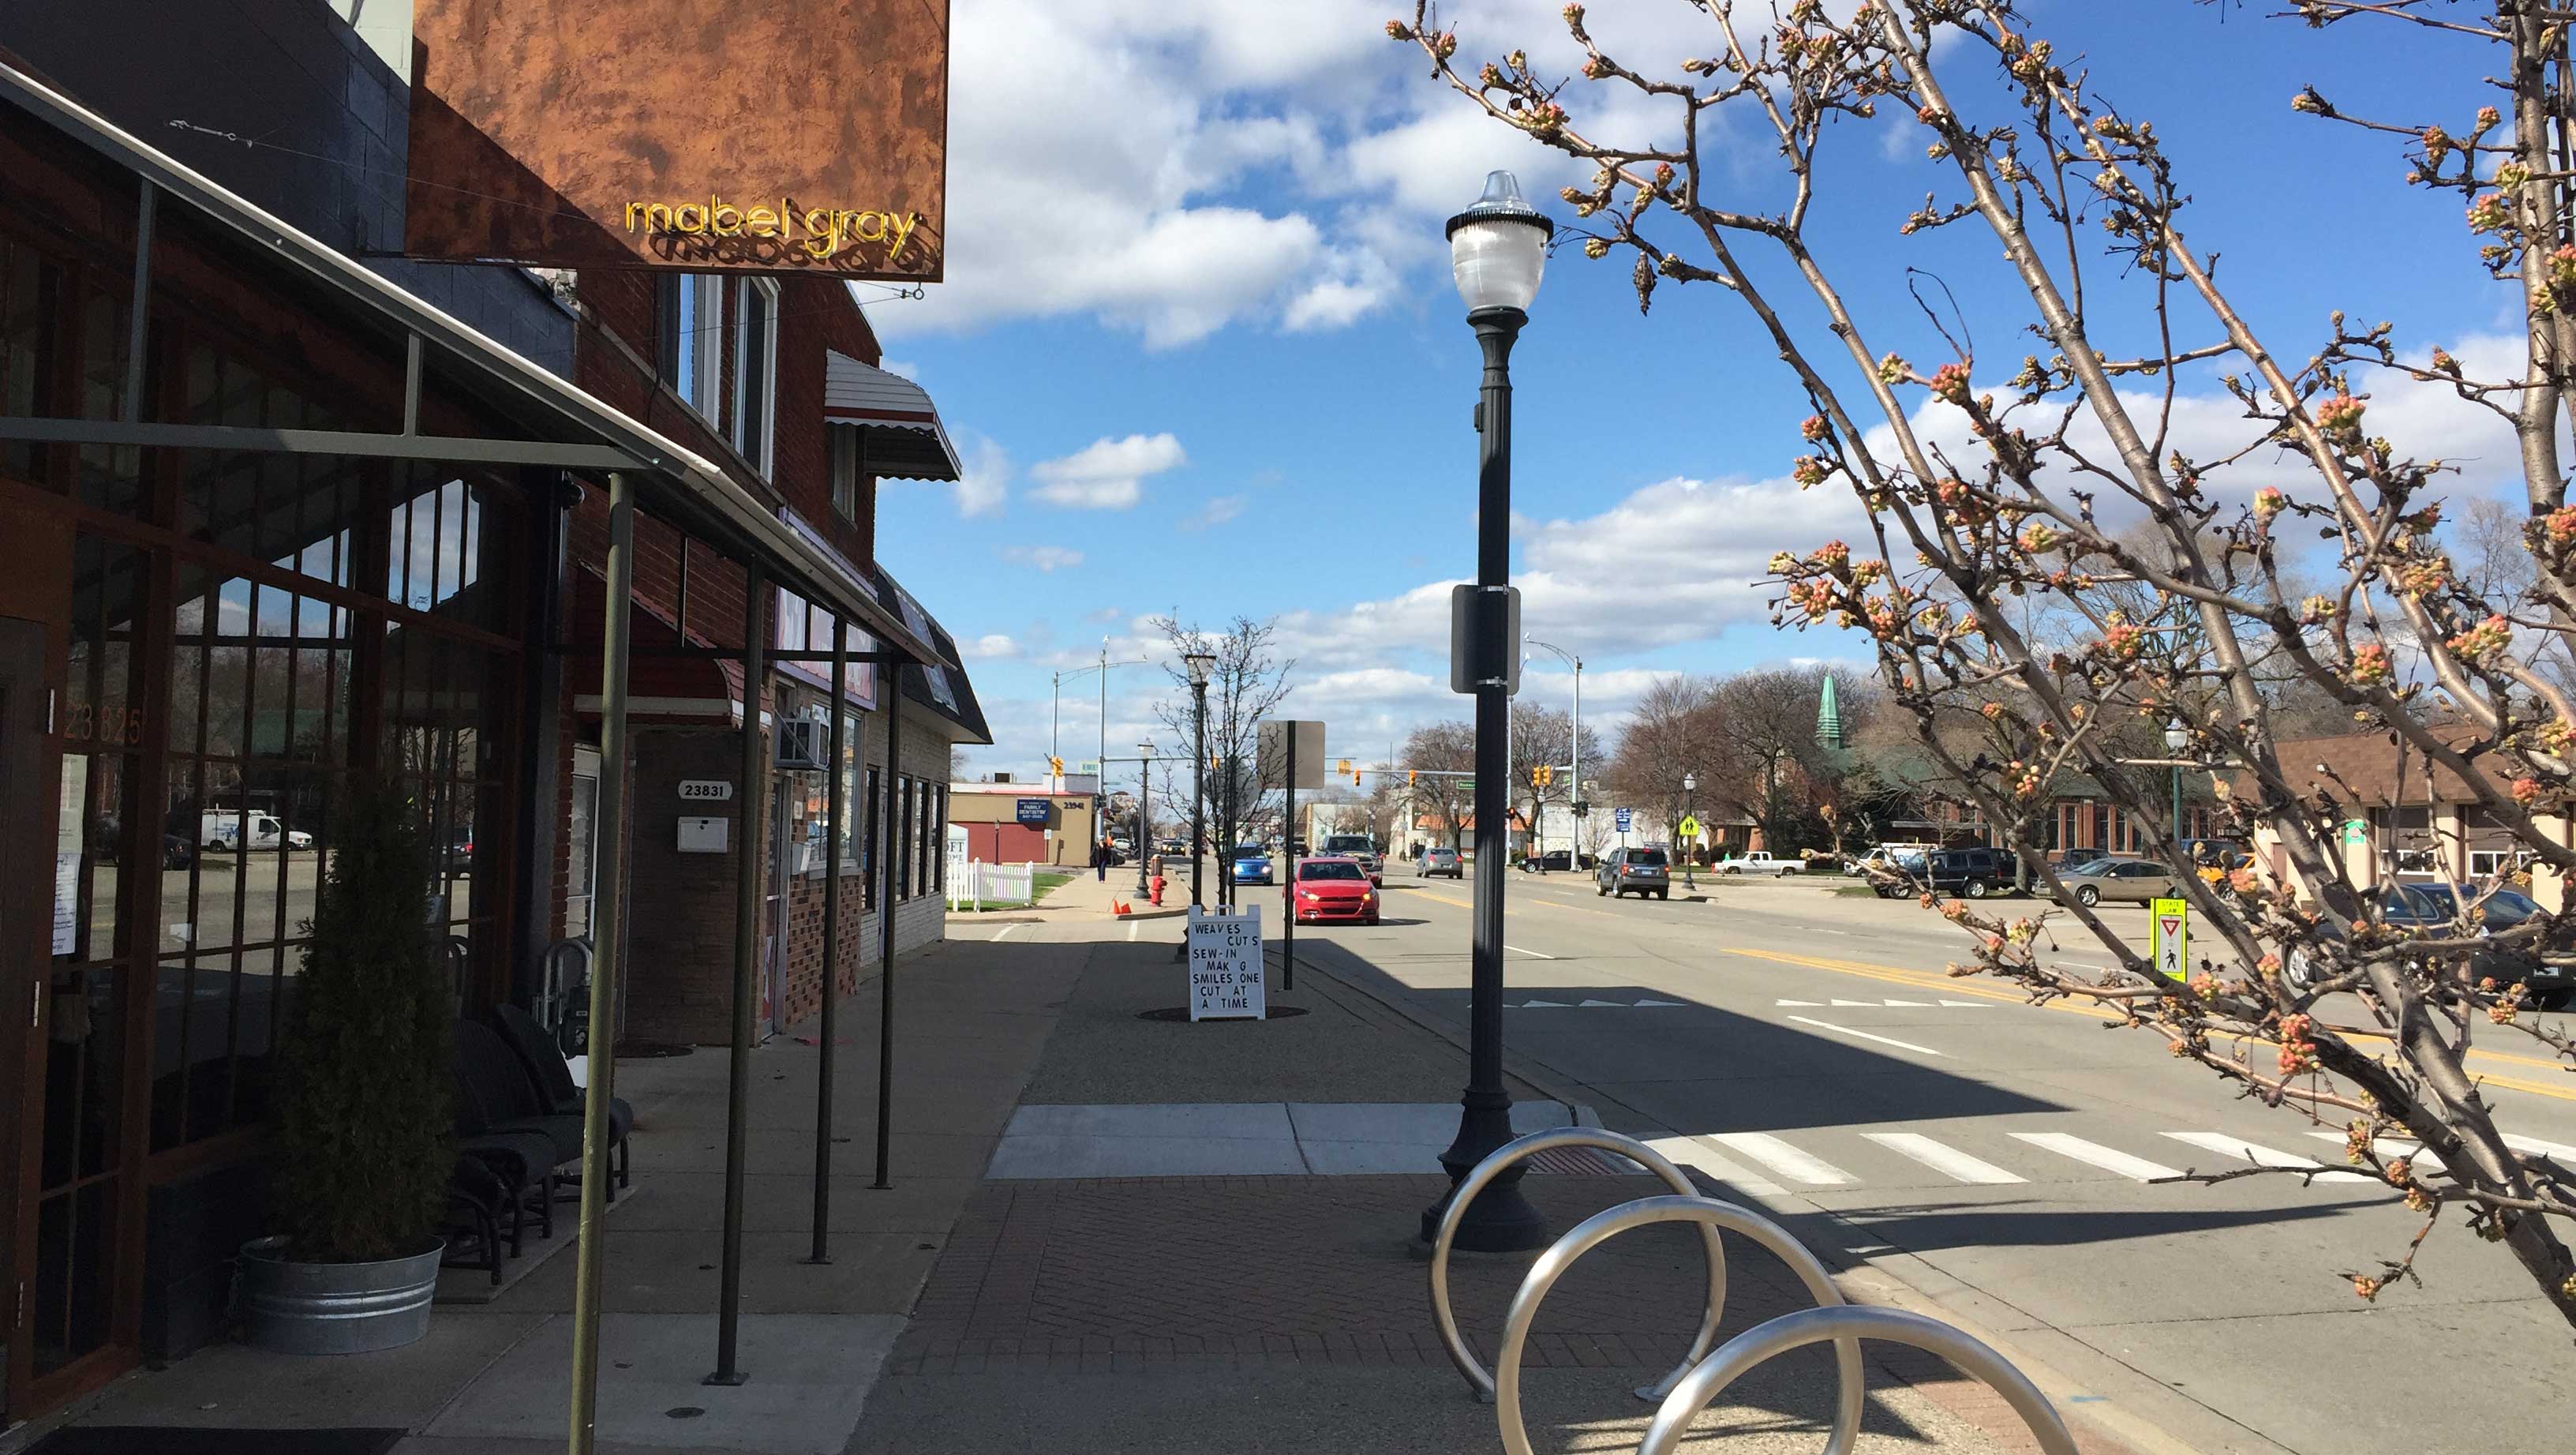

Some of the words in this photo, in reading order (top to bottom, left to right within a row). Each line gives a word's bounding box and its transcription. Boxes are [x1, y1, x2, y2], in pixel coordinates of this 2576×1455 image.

[626, 194, 789, 238] mabel
[804, 208, 917, 260] gray
[684, 785, 724, 797] 23831
[947, 842, 964, 853] FT
[1195, 924, 1241, 935] WEAVES
[1227, 936, 1258, 947] CUTS
[1193, 948, 1237, 959] SEW-IN
[1193, 973, 1233, 984] SMILES
[1240, 973, 1260, 984] ONE
[1200, 986, 1220, 997] CUT
[1234, 986, 1247, 996] AT
[1202, 998, 1209, 1009] A
[1221, 998, 1249, 1009] TIME
